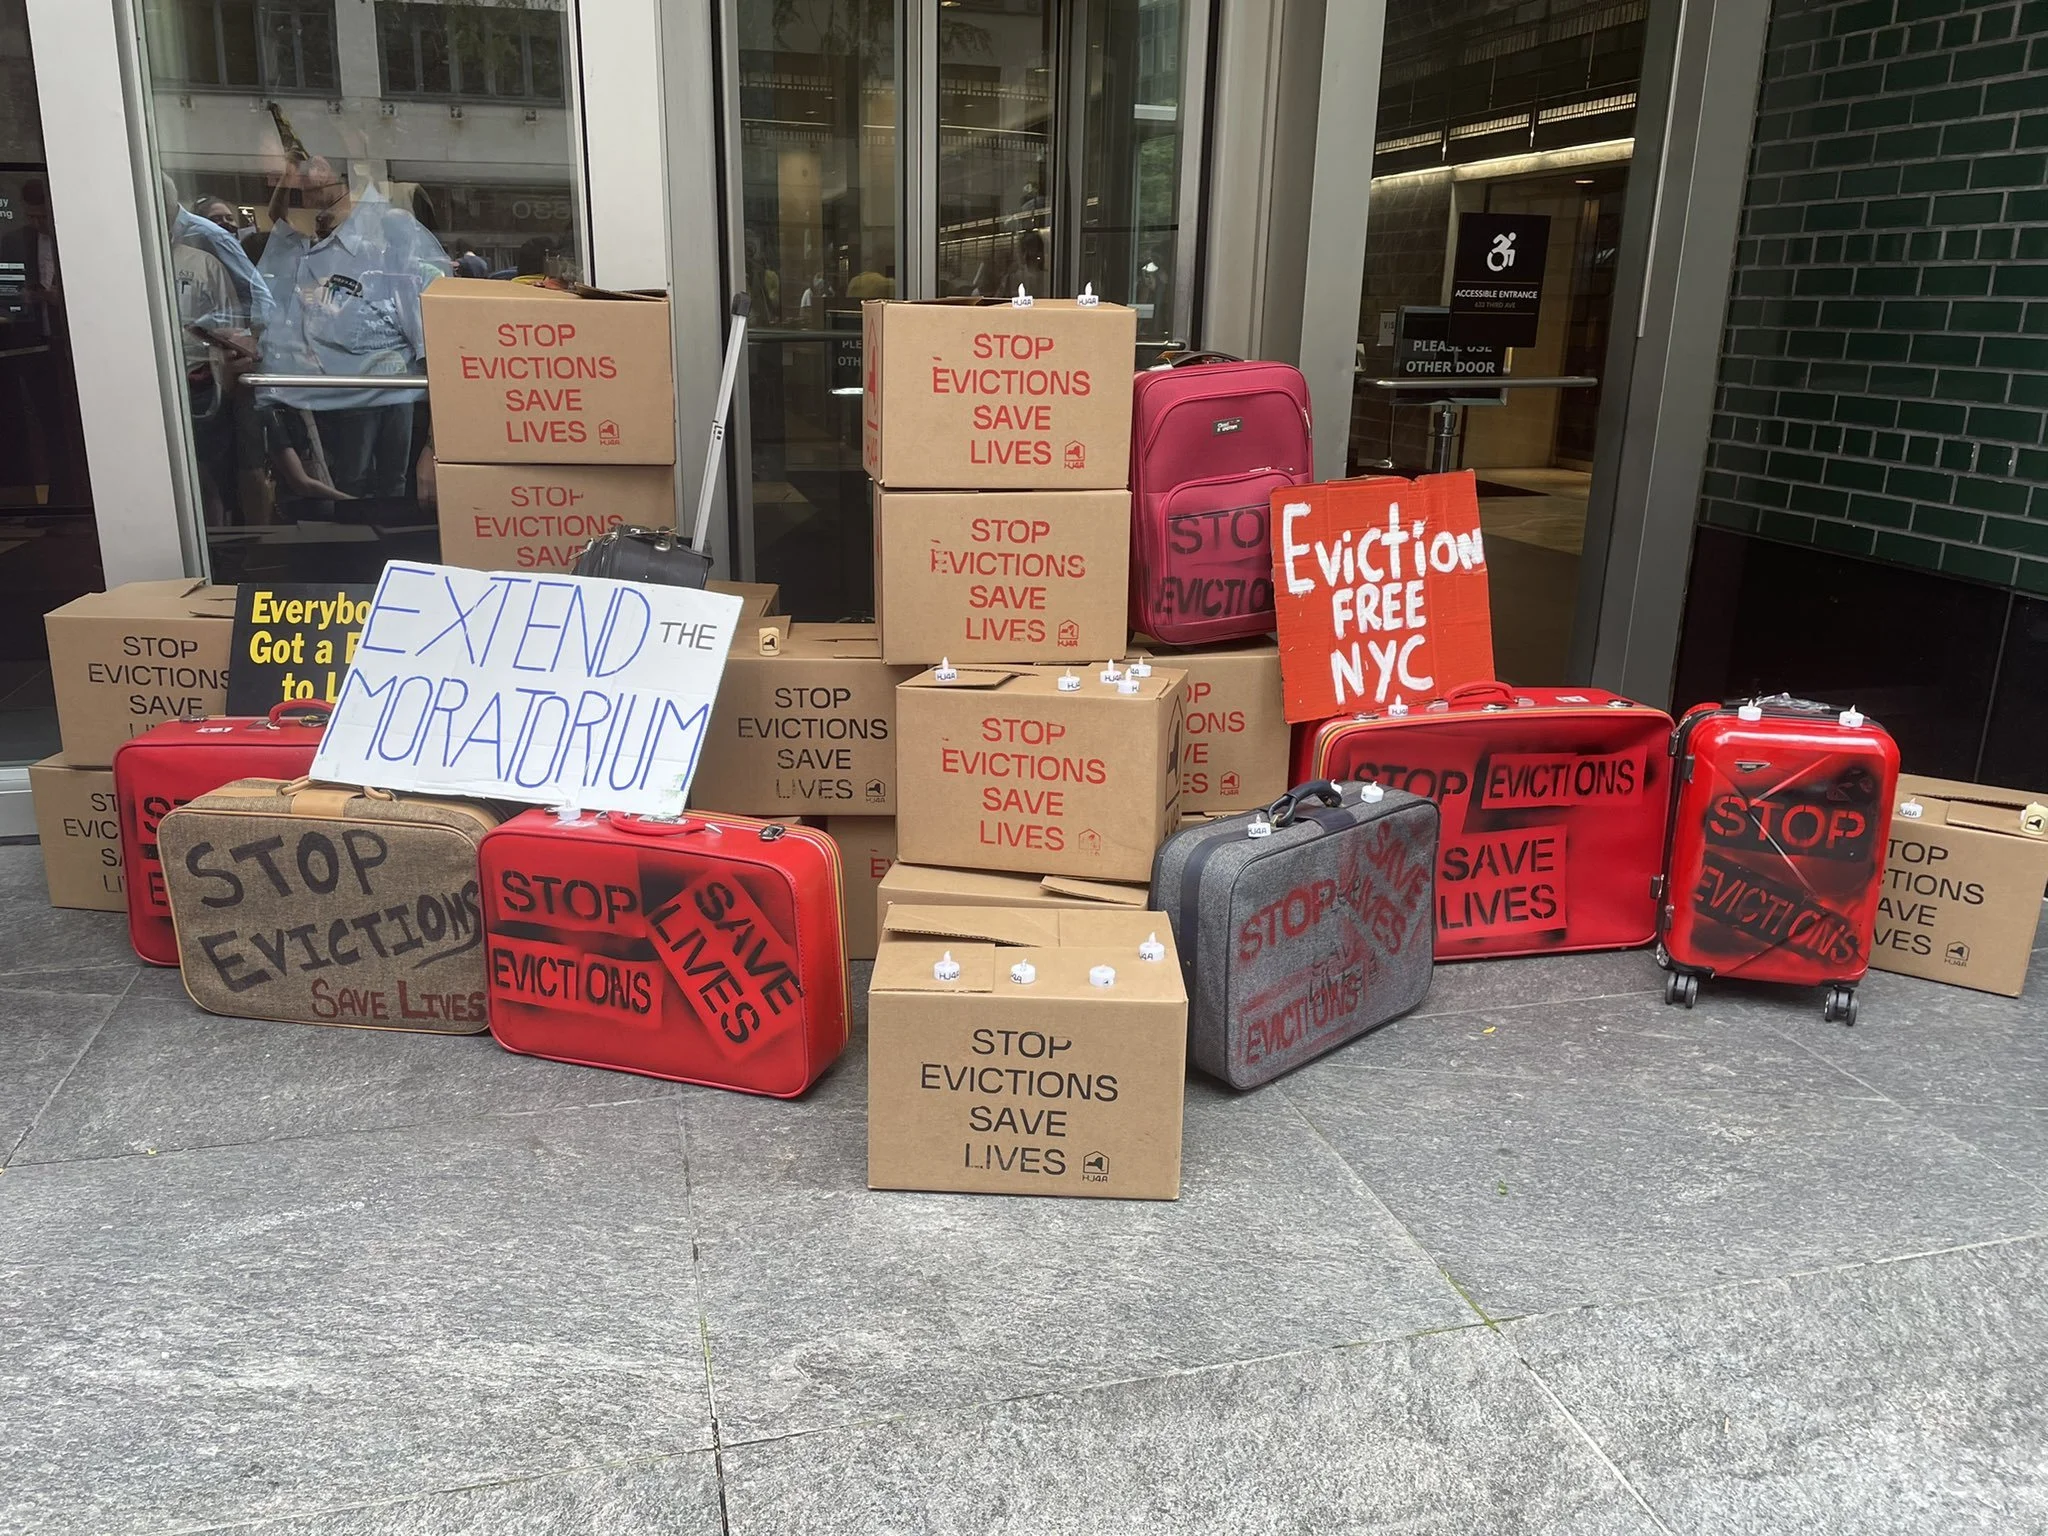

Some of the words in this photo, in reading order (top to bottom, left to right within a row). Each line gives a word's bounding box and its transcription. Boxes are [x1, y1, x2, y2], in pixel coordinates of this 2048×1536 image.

[1455, 289, 1498, 298] ACCESSIBLE
[1499, 290, 1538, 299] ENTRANCE
[498, 323, 576, 347] STOP
[842, 340, 862, 349] PLE
[973, 333, 1055, 360] STOP
[461, 356, 617, 379] EVICTIONS
[838, 356, 861, 366] OTH
[1406, 361, 1452, 373] OTHER
[1455, 361, 1495, 373] DOOR
[932, 366, 1091, 396] EVICTIONS
[505, 389, 583, 411] SAVE
[506, 420, 587, 443] LIVES
[972, 405, 1051, 431] SAVE
[970, 439, 1052, 465] LIVES
[971, 518, 1050, 543] STOP
[1169, 509, 1265, 555] STO
[930, 549, 1086, 578] EVICTIONS
[252, 592, 371, 630] Everybo
[968, 585, 1047, 610] SAVE
[1155, 577, 1273, 617] EVICTIO
[1332, 580, 1427, 639] FREE
[362, 566, 651, 678] EXTEND
[660, 621, 717, 650] THE
[965, 617, 1046, 643] LIVES
[123, 636, 199, 659] STOP
[249, 631, 304, 664] Got
[315, 639, 333, 664] a
[1330, 634, 1434, 705] NYC
[282, 673, 314, 701] to
[775, 687, 851, 709] STOP
[129, 694, 203, 715] SAVE
[320, 668, 710, 791] MORATORIUM
[737, 717, 888, 740] EVICTIONS
[982, 718, 1066, 745] STOP
[777, 748, 851, 769] SAVE
[942, 748, 1107, 785] EVICTIONS
[776, 778, 853, 800] LIVES
[1489, 759, 1635, 801] EVICTIONS
[91, 793, 117, 812] ST
[982, 787, 1064, 817] SAVE
[979, 819, 1064, 851] LIVES
[1710, 795, 1866, 849] STOP
[1366, 822, 1430, 912] SAVE
[1442, 838, 1555, 882] SAVE
[1889, 839, 1948, 865] TOP
[185, 829, 388, 909] STOP
[502, 870, 638, 924] STOP
[1882, 868, 1984, 905] TIONS
[1239, 878, 1336, 961] STOP
[1440, 884, 1556, 930] LIVES
[1693, 865, 1860, 964] EVICTIONS
[1878, 897, 1937, 927] AVE
[198, 880, 482, 993] EVICTIONS
[694, 881, 805, 1015] SAVE
[1874, 928, 1932, 955] VES
[493, 947, 651, 1015] EVICTIONS
[651, 903, 760, 1044] LIVES
[311, 977, 389, 1021] SAVE
[397, 981, 487, 1022] LIVES
[1247, 975, 1362, 1065] EVICTIONS
[971, 1028, 1072, 1058] STOP
[921, 1063, 1119, 1102] EVICTIONS
[969, 1105, 1067, 1137] SAVE
[965, 1143, 1066, 1175] LIVES
